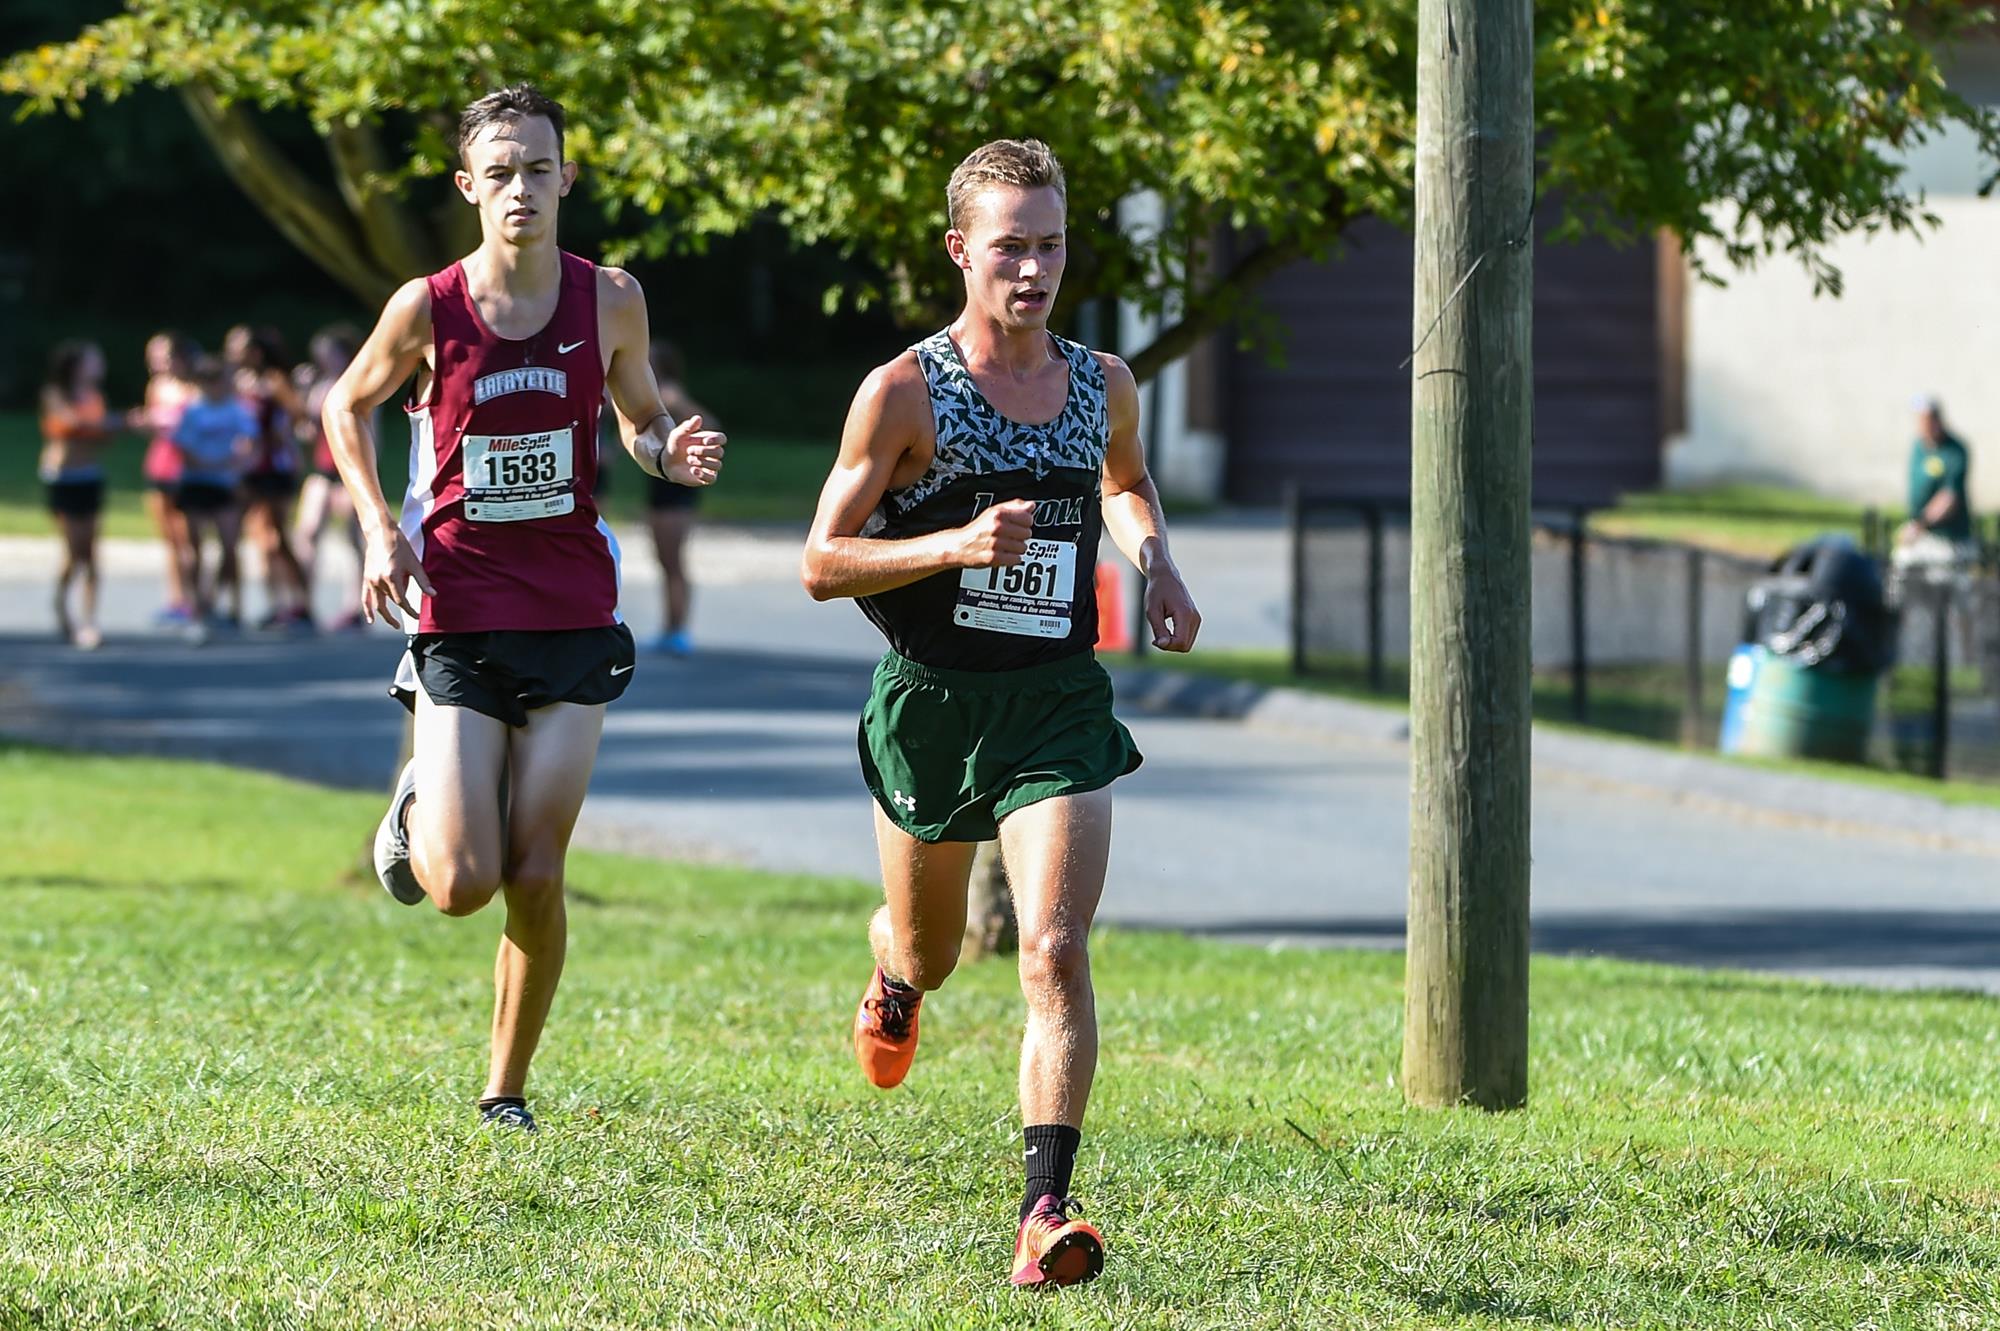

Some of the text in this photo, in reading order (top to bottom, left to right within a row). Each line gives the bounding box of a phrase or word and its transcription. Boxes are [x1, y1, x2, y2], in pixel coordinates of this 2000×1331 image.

[476, 368, 565, 401] LAFAYETTE
[488, 434, 551, 452] MileSplit
[484, 451, 557, 486] 1533
[971, 492, 1084, 527] LOLA
[1026, 542, 1060, 560] Split
[987, 561, 1058, 598] 1561
